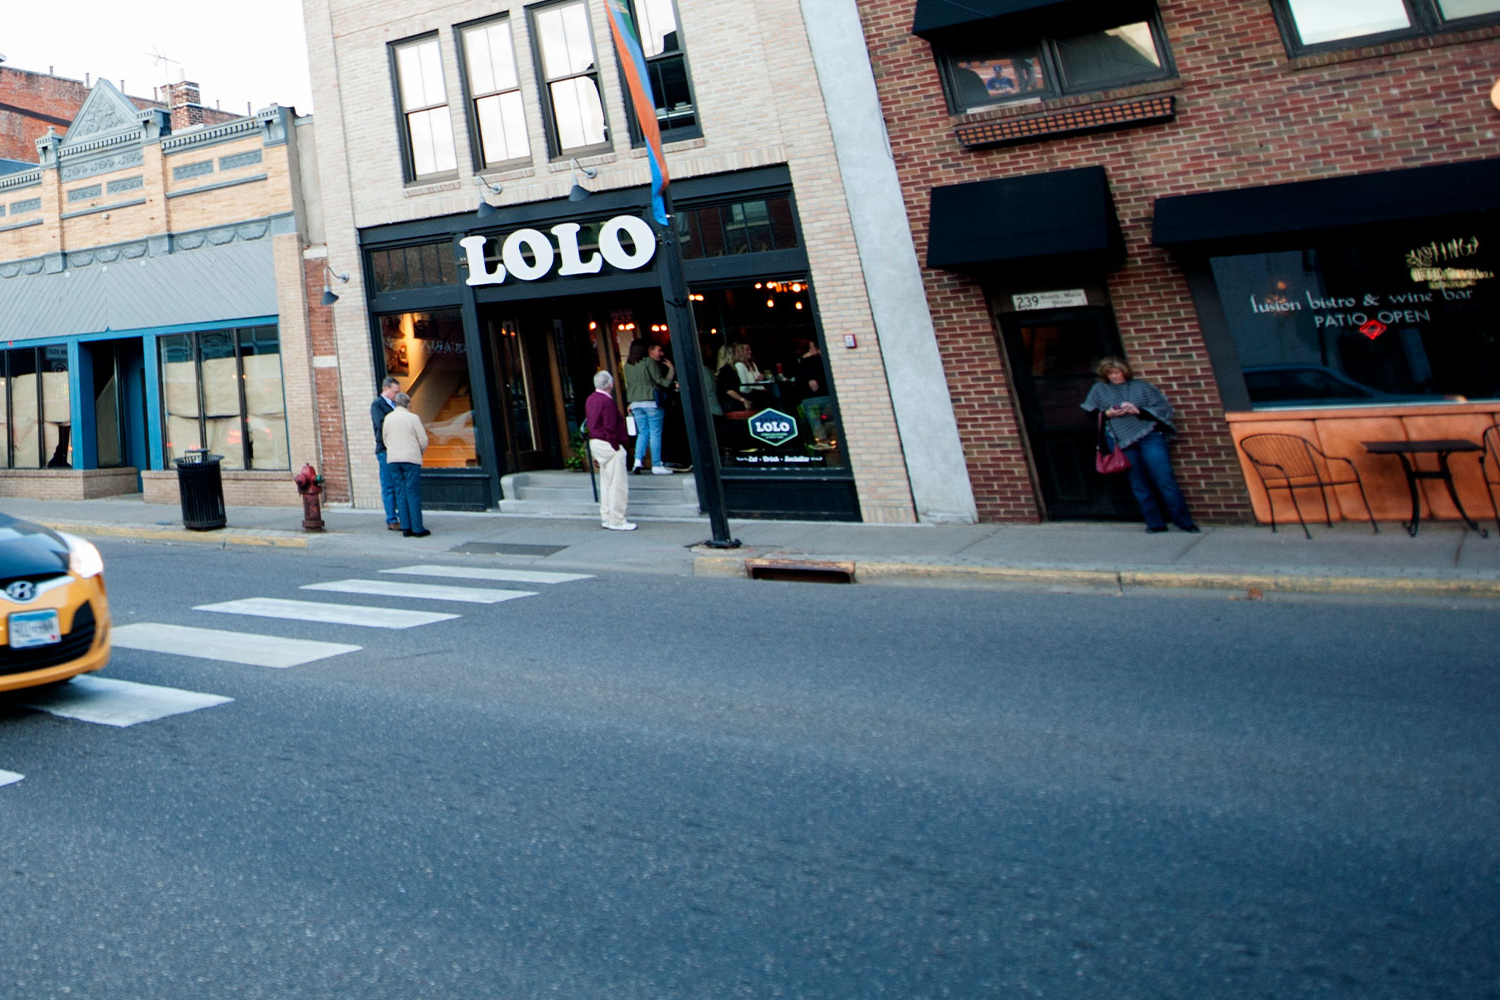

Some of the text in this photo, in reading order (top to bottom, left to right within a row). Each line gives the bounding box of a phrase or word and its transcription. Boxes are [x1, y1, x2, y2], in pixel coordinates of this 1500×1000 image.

[459, 214, 656, 286] LOLO
[1016, 295, 1039, 309] 239
[1306, 290, 1356, 310] bistro
[1363, 293, 1380, 307] &
[1388, 290, 1434, 303] wine
[1439, 281, 1474, 300] bar
[1314, 309, 1431, 328] PATIO OPEN
[755, 421, 790, 433] LOLO
